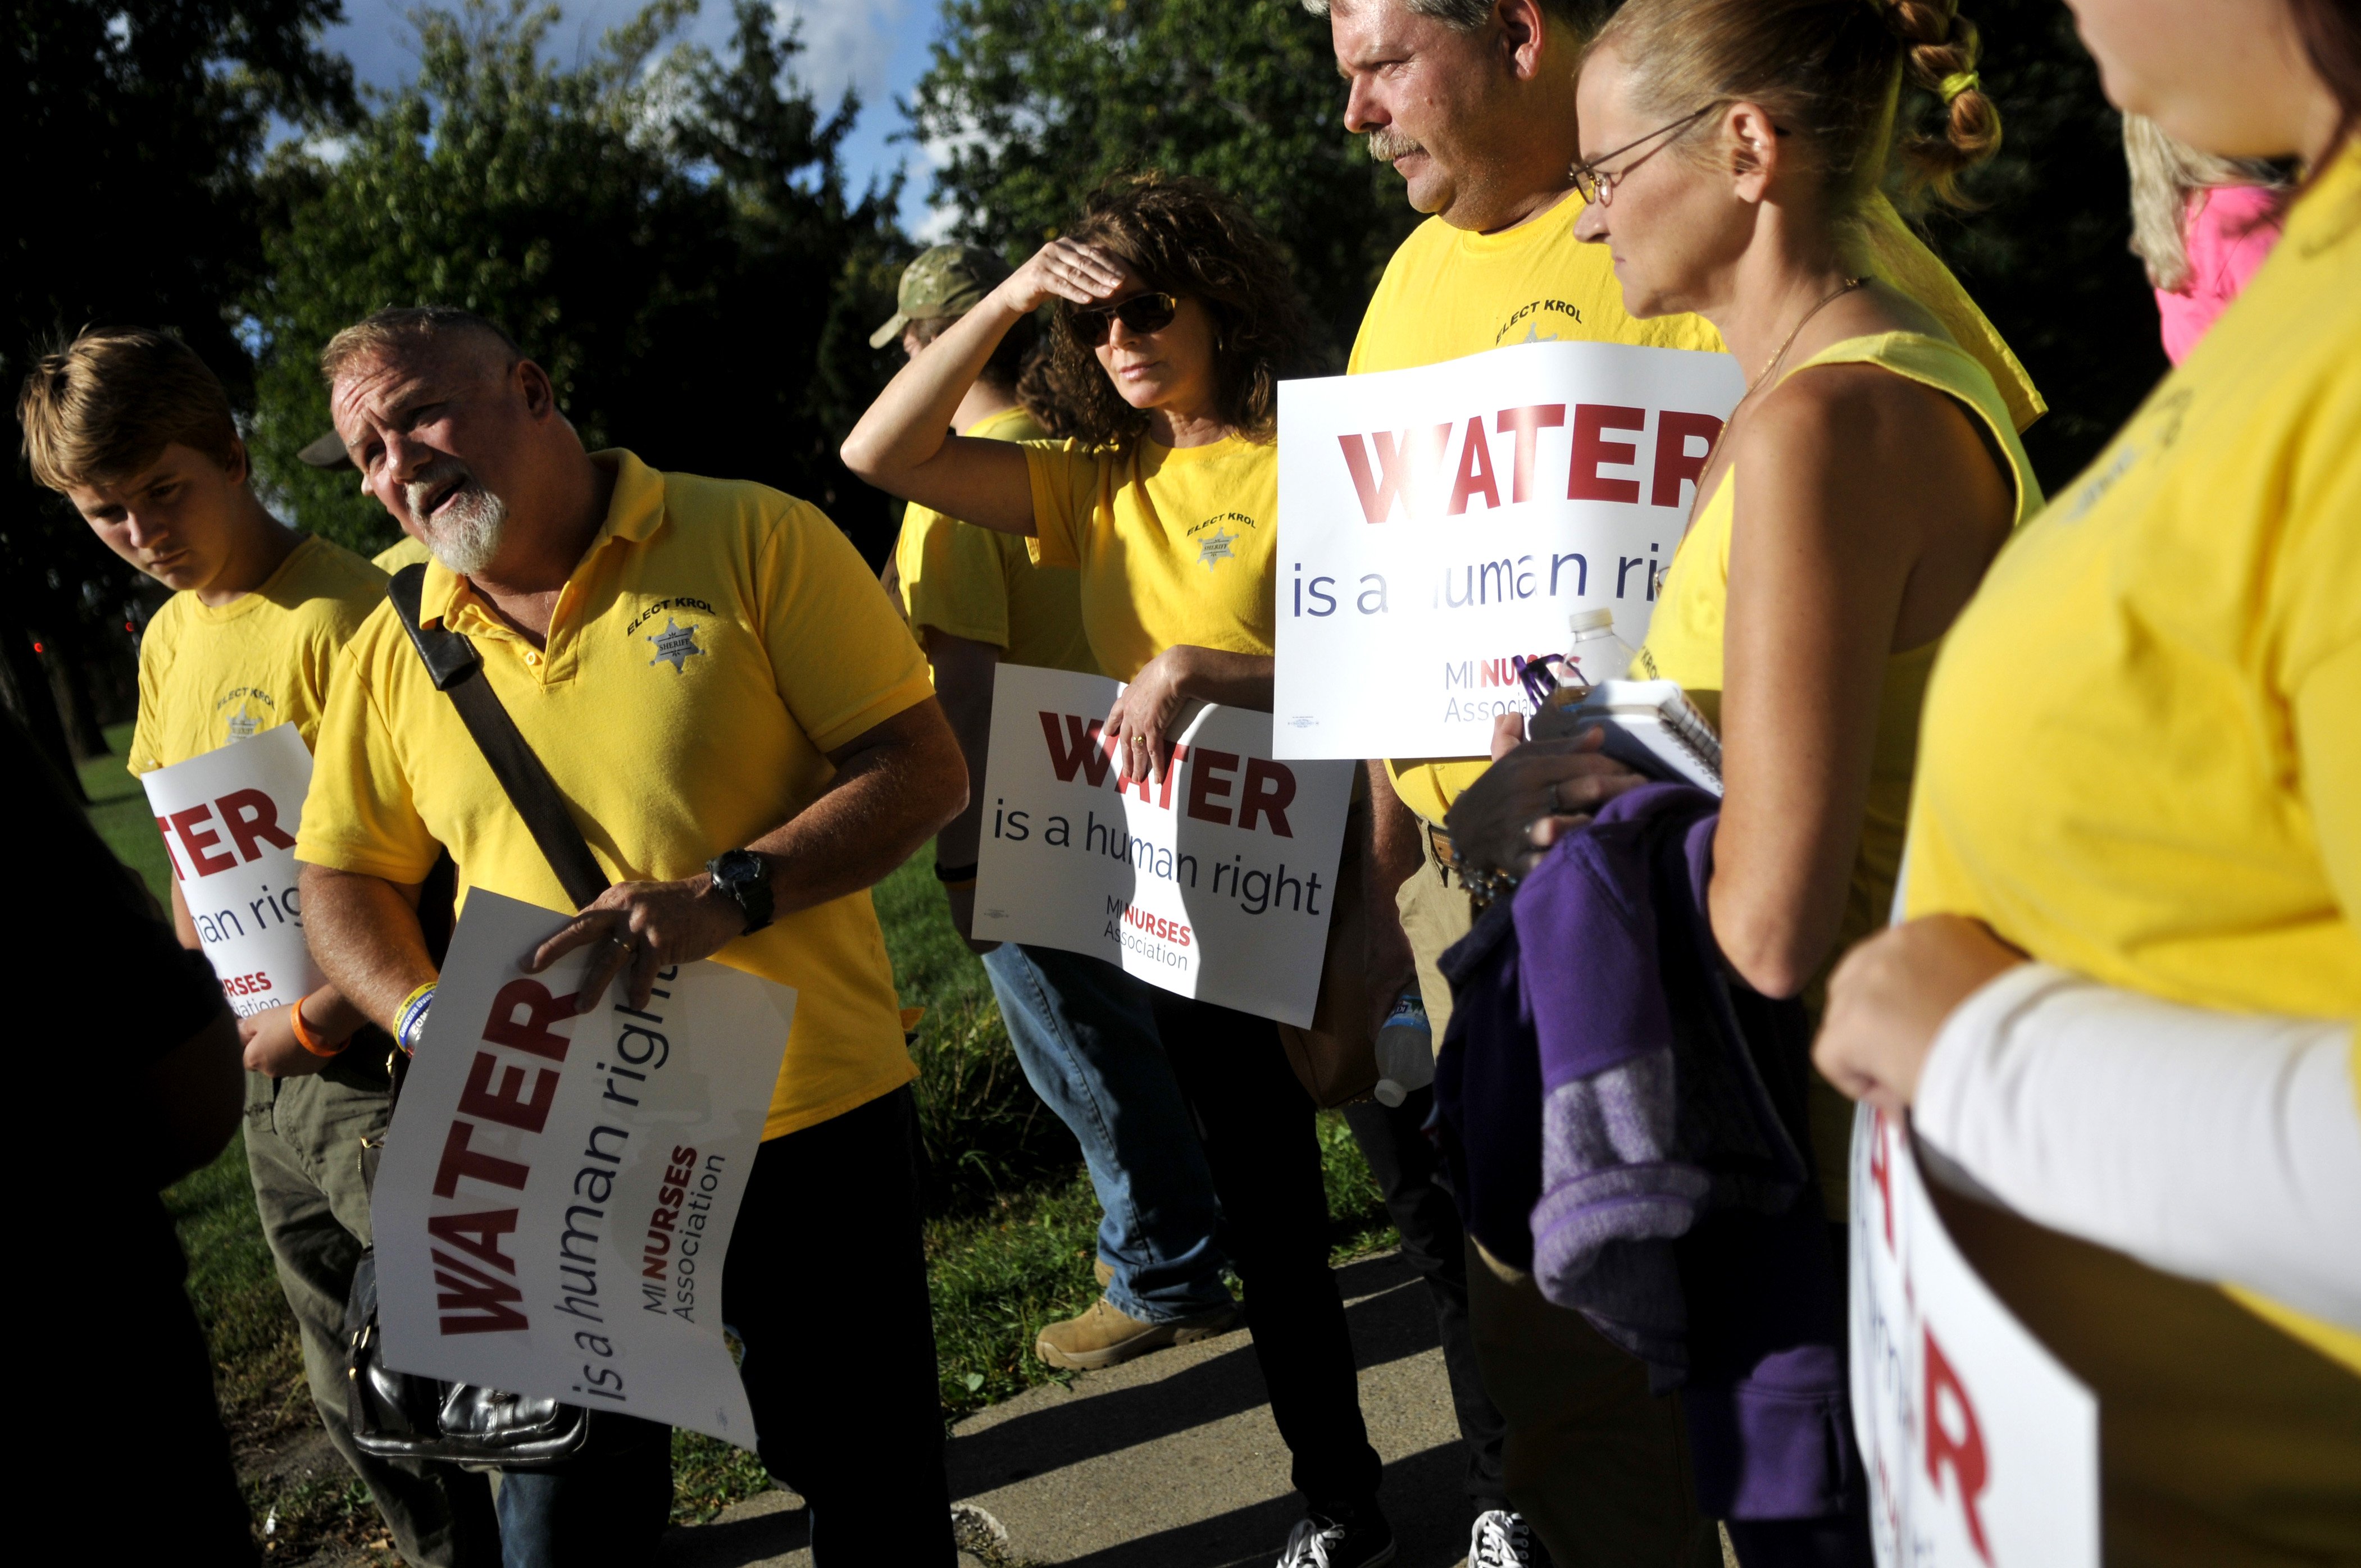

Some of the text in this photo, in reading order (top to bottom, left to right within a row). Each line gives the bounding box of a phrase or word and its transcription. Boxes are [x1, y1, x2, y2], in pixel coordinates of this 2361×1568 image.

[1496, 299, 1582, 346] ELECT KROL
[1338, 403, 1727, 524] WATER
[1187, 512, 1256, 536] ELECT KROL
[1294, 563, 1336, 617] is
[1357, 573, 1388, 614] a
[1433, 553, 1587, 609] uman
[627, 598, 716, 637] ELECT KROL
[659, 639, 689, 650] SHERIFF
[1641, 649, 1660, 680] KRO
[217, 687, 248, 710] ELECT
[1446, 660, 1473, 690] MI
[994, 798, 1322, 914] is a human right
[1107, 895, 1191, 947] MI NURSES
[1104, 920, 1188, 970] Association
[399, 1006, 418, 1038] Concern
[428, 978, 579, 1335] WATER
[554, 1125, 629, 1316] human
[642, 1145, 697, 1316] MI NURSES
[674, 1154, 725, 1323] Association
[574, 1333, 613, 1360] a
[572, 1365, 626, 1401] is
